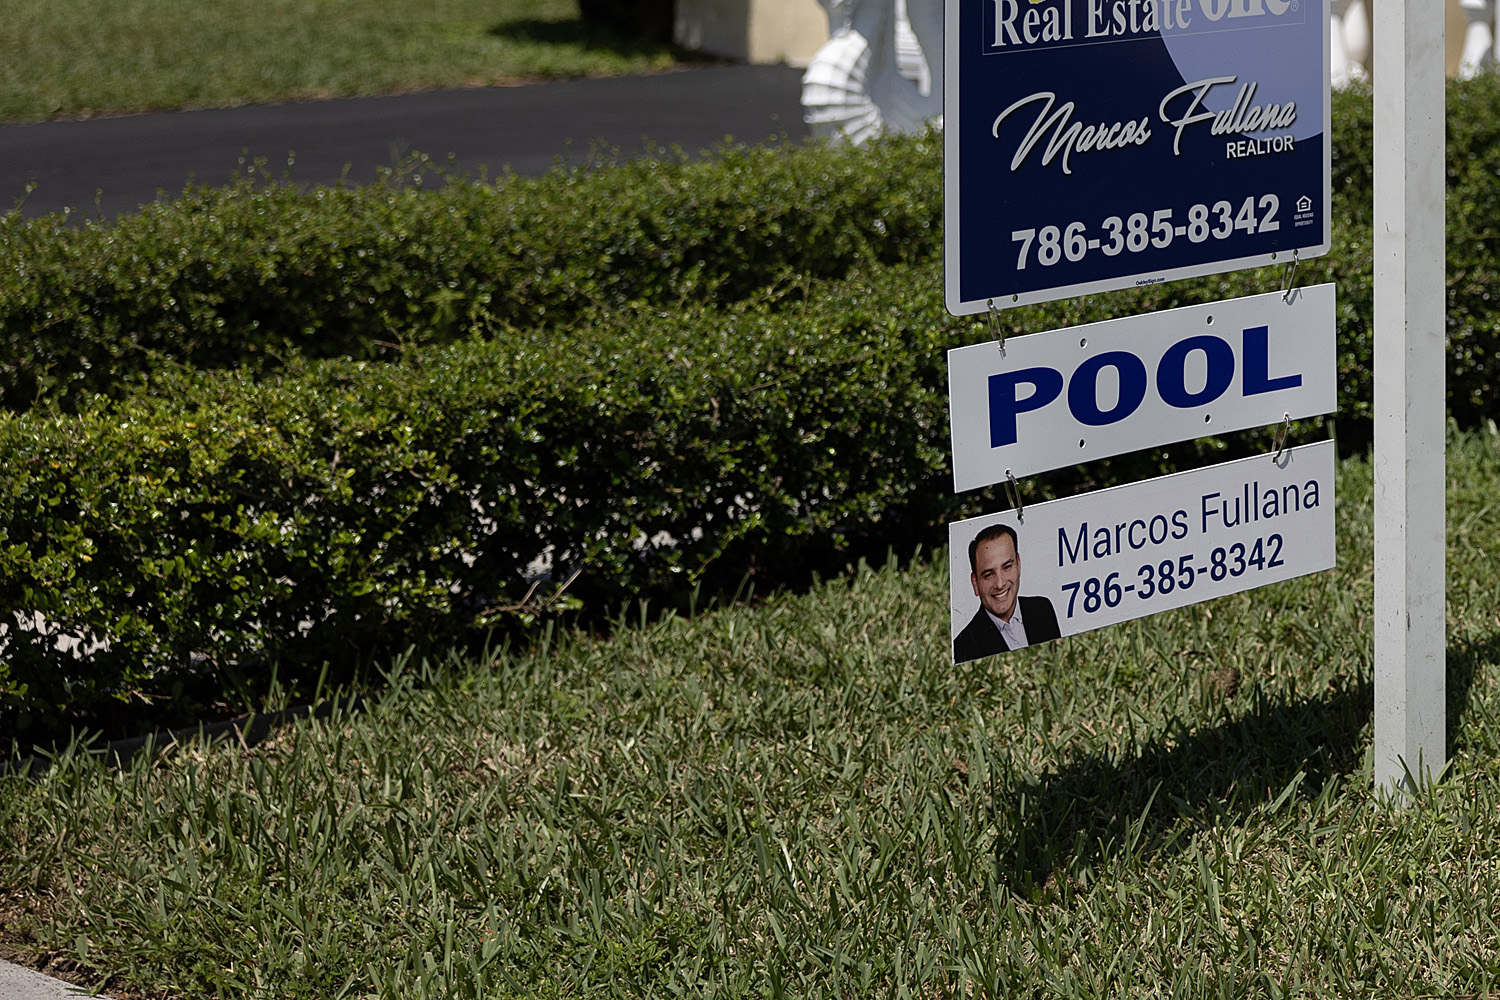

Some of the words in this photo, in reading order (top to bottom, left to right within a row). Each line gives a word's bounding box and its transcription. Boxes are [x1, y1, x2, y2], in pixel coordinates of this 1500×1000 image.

[992, 91, 1151, 174] Marcos
[1159, 75, 1296, 156] Fullana
[1226, 135, 1294, 159] REALTOR
[1011, 193, 1280, 270] 786-385-8342
[988, 325, 1303, 449] POOL
[1057, 508, 1188, 567] Marcos
[1201, 479, 1320, 533] Fullana
[1061, 533, 1285, 619] 786-385-8342
